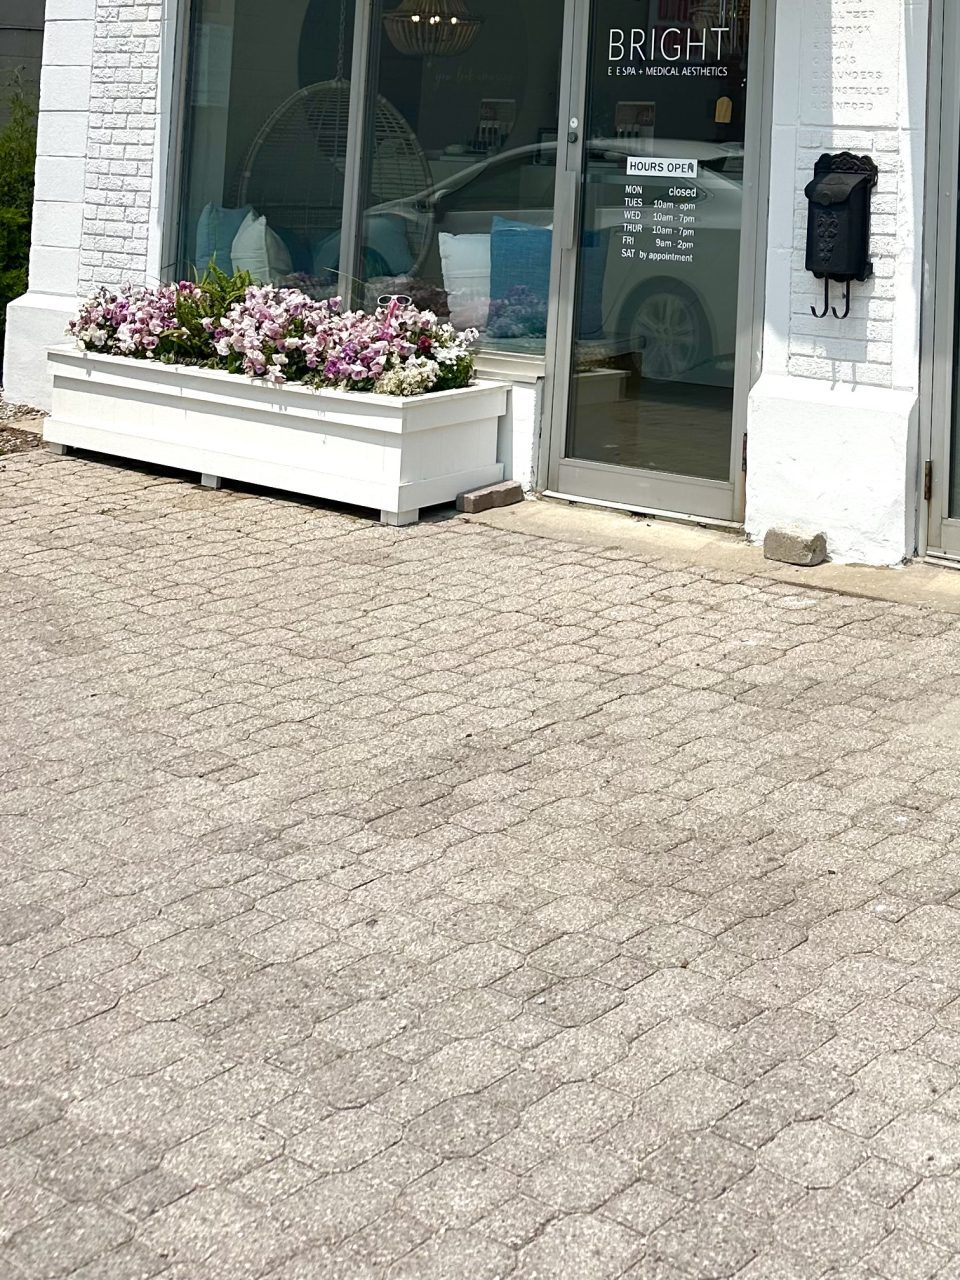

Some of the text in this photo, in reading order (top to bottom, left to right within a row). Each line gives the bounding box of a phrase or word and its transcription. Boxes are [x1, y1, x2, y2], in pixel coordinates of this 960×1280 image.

[609, 27, 730, 61] BRIGHT
[622, 66, 637, 76] SPA
[645, 66, 680, 76] MEDICAL
[681, 66, 728, 76] AESTHETICS
[629, 161, 664, 172] HOURS
[624, 185, 697, 197] MON closed
[624, 197, 643, 207] TUES
[653, 199, 674, 209] 10am
[623, 210, 641, 220] WED
[652, 212, 673, 222] 10am
[679, 213, 695, 224] 7pm
[623, 223, 643, 233] THUR
[652, 225, 673, 235] 10am
[678, 226, 694, 237] 7pm
[622, 235, 635, 245] FRI
[655, 238, 672, 248] 9am
[677, 239, 694, 250] 2pm
[621, 248, 693, 262] SAT by appointment
